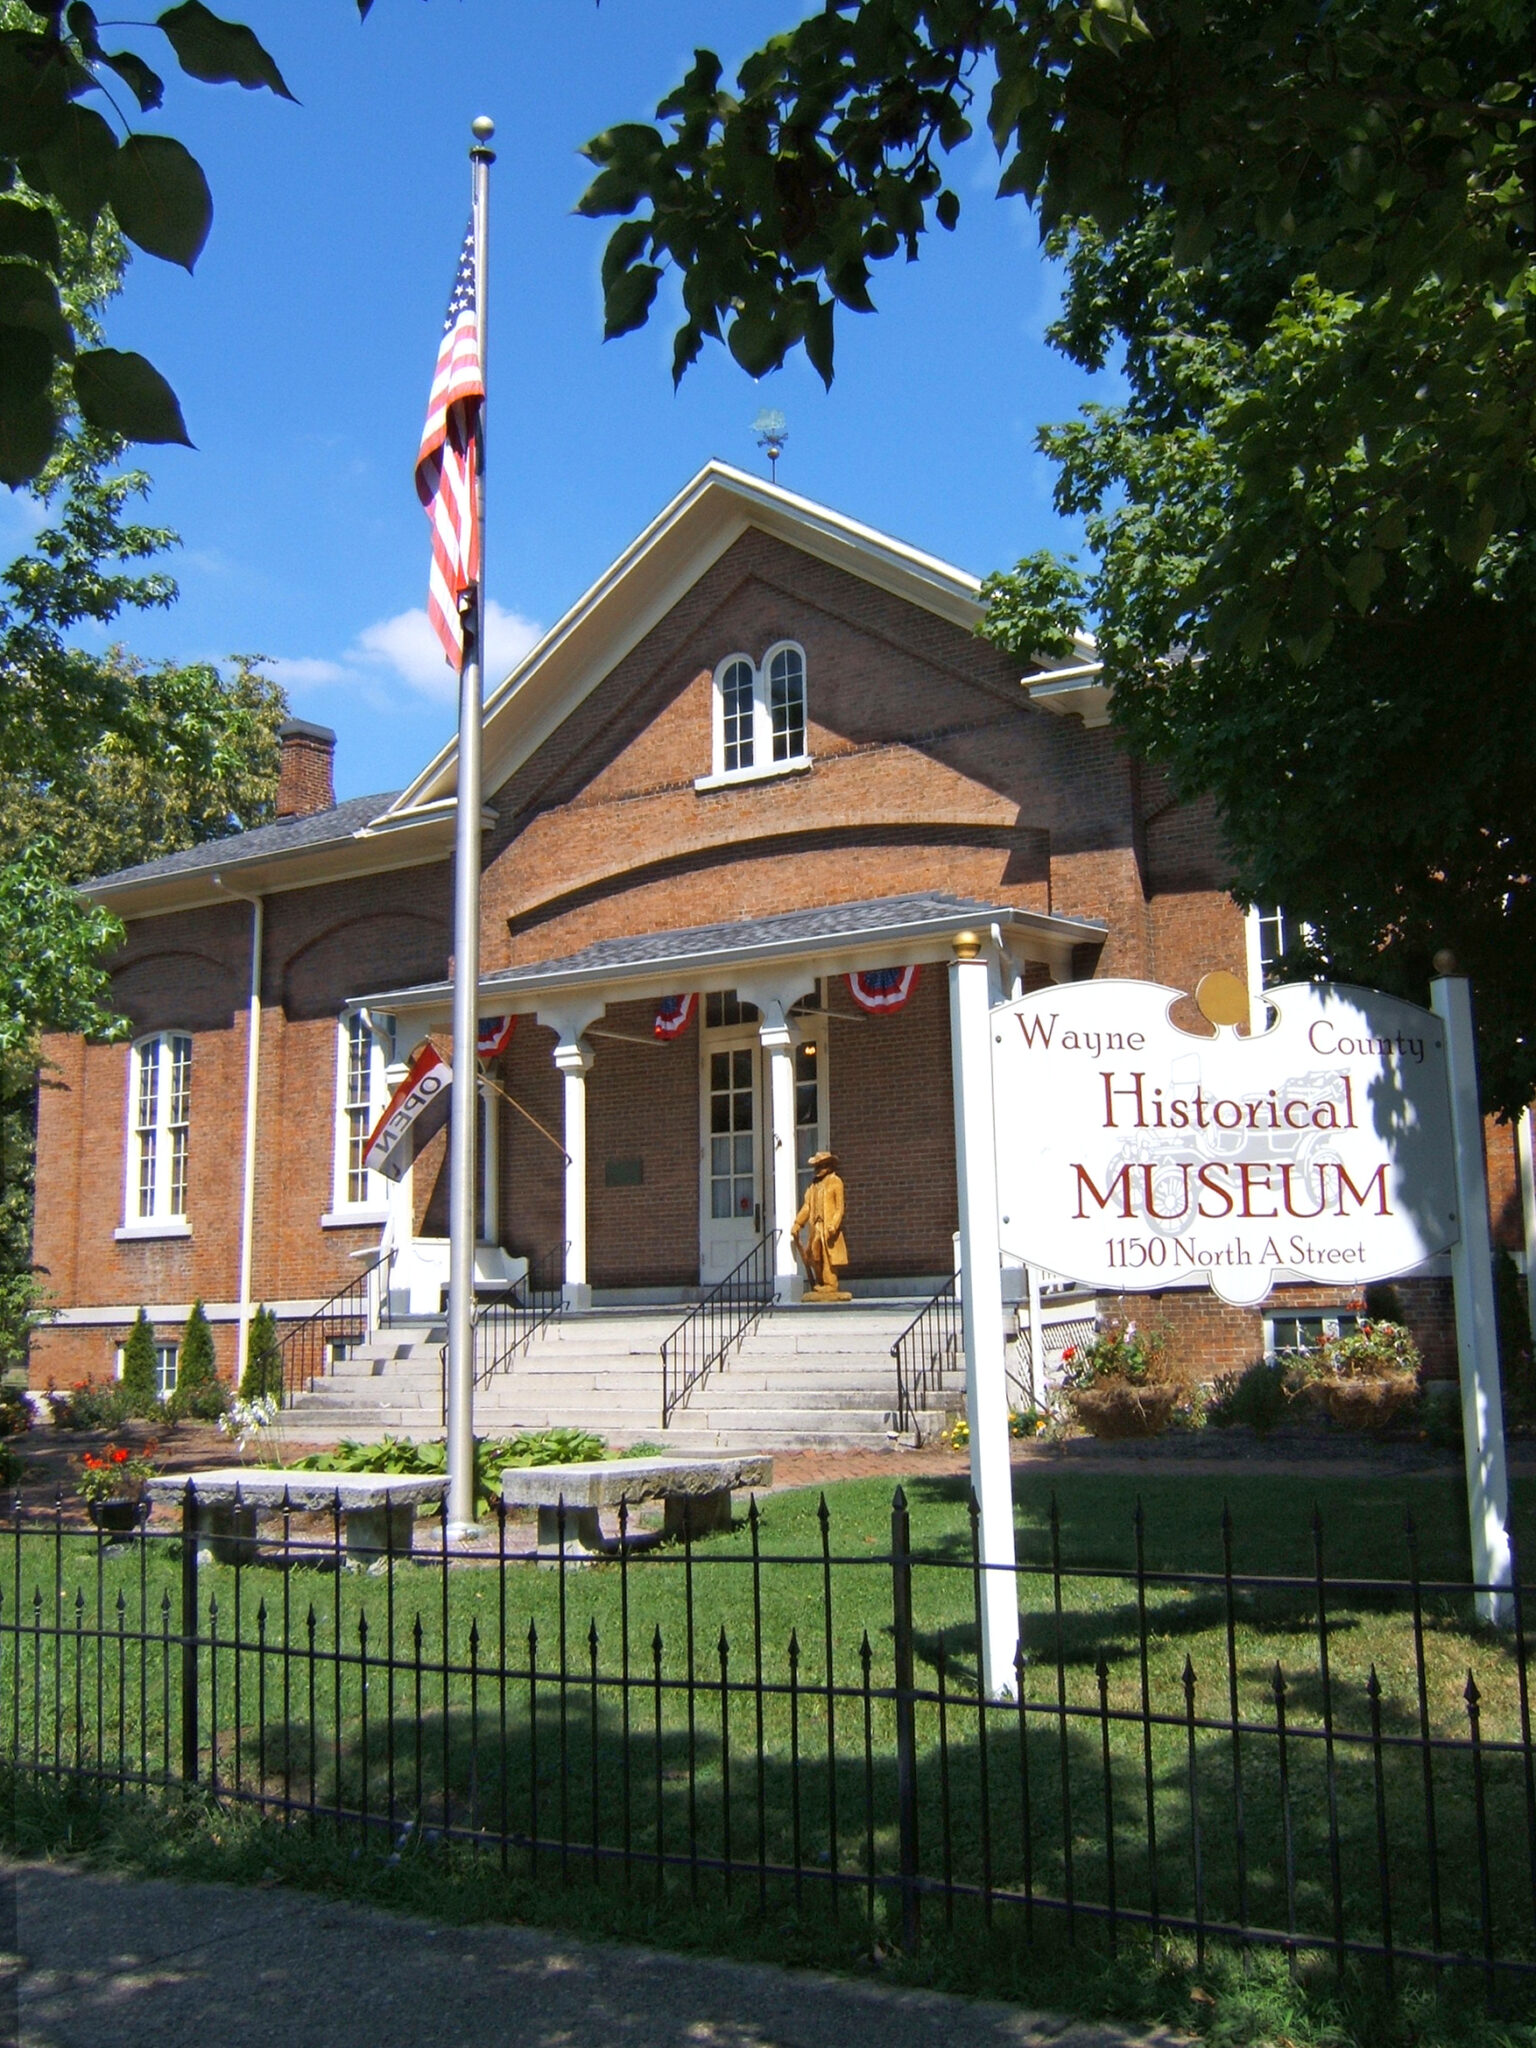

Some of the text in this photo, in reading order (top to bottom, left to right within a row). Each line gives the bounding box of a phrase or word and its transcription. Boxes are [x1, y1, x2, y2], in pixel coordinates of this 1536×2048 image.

[1014, 1012, 1425, 1063] Wayne County
[1099, 1071, 1359, 1129] Historical
[1070, 1162, 1394, 1219] MUSEUM
[1105, 1235, 1367, 1268] 1150 North A Street
